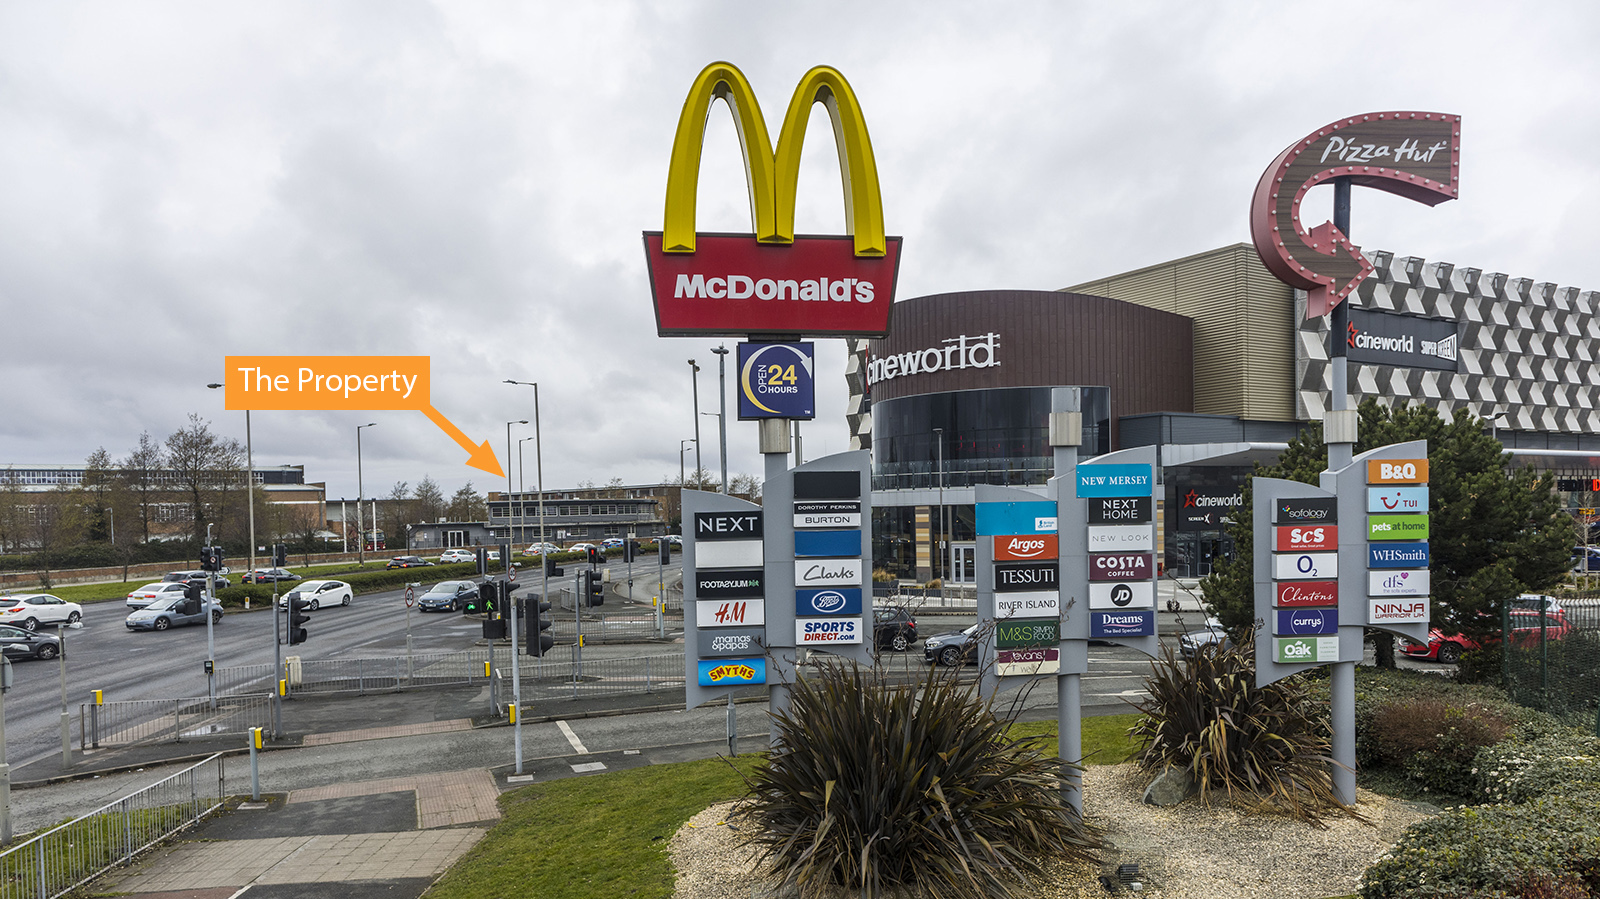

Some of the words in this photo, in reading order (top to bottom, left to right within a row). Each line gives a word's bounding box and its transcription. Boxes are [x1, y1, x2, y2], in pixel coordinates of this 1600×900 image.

[1320, 136, 1391, 164] Pizza
[1394, 138, 1447, 162] Hut
[674, 274, 875, 303] McDonald's
[1355, 331, 1414, 353] cineworld
[1420, 340, 1437, 356] SUPER
[867, 332, 994, 386] cineworld
[758, 364, 767, 394] OPEN
[768, 364, 798, 386] 24
[1381, 463, 1416, 480] B&Q
[1082, 476, 1106, 486] NEW
[1109, 476, 1148, 485] MERSEY
[1103, 500, 1138, 509] NEXT
[1196, 494, 1242, 506] cineworld
[1103, 510, 1138, 519] HOME
[1289, 508, 1328, 518] sofology
[700, 516, 758, 532] NEXT
[1372, 522, 1391, 532] pets
[1392, 522, 1400, 530] at
[1402, 522, 1426, 530] home
[1290, 528, 1325, 543] ScS
[1008, 538, 1044, 552] Argos
[1373, 550, 1426, 560] WHSmith
[1096, 556, 1145, 570] COSTA
[1297, 556, 1318, 576] O2
[804, 565, 854, 581] Clarks
[1000, 569, 1054, 583] TESSUTI
[700, 580, 748, 588] FOOTASYLUM
[1383, 575, 1403, 588] dfs
[1114, 590, 1130, 602] JD
[1282, 586, 1334, 602] Clintons
[999, 601, 1022, 610] RIVER
[1026, 600, 1056, 608] ISLAND
[1375, 603, 1424, 613] NINJA
[715, 602, 746, 624] H&M
[1102, 614, 1143, 624] Dreams
[804, 622, 854, 632] SPORTS
[1294, 618, 1322, 628] currys
[804, 633, 854, 641] DIRECT.COM
[1000, 626, 1032, 641] M&S
[712, 640, 748, 651] &papas
[1284, 642, 1311, 655] Oak
[710, 666, 754, 680] SMYTHS
